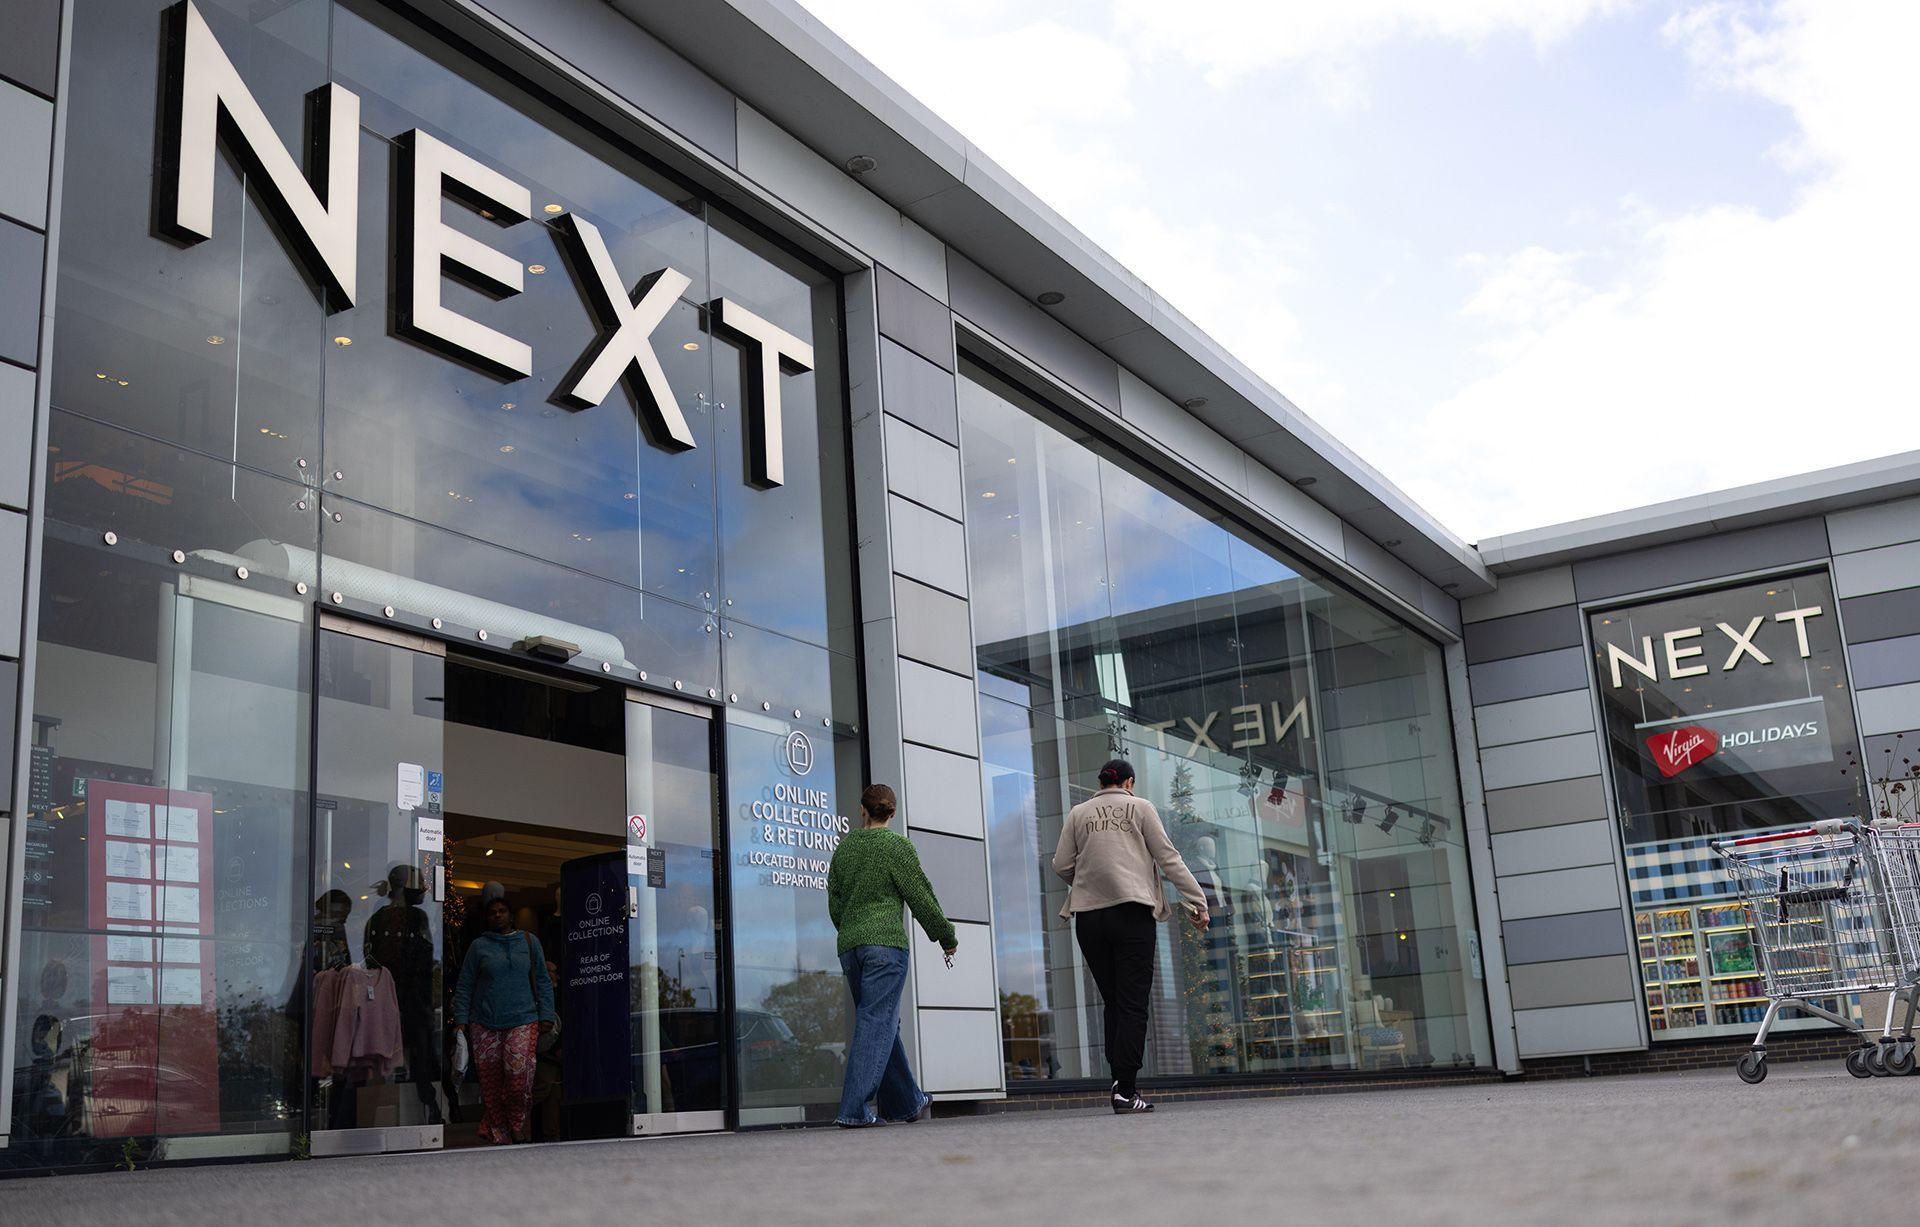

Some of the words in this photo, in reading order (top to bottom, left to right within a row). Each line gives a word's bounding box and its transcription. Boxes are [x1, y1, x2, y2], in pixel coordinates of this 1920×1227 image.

[156, 0, 813, 488] NEXT
[1607, 606, 1823, 688] NEXT
[1663, 731, 1704, 766] Virgin
[1721, 721, 1818, 749] HOLIDAYS
[774, 783, 829, 809] ONLINE
[751, 800, 850, 834] COLLECTIONS
[1086, 819, 1133, 834] nurse.
[763, 824, 774, 843] &
[777, 826, 841, 852] RETURNS
[749, 850, 796, 870] LOCATED
[797, 856, 807, 871] IN
[772, 871, 829, 890] DEPARTMEN
[578, 916, 610, 929] ONLINE
[568, 925, 624, 941] COLLECTIONS
[580, 955, 599, 965] REAR
[600, 953, 610, 962] OF
[580, 963, 611, 975] WOMENS
[569, 976, 598, 987] GROUND
[599, 972, 624, 983] FLOOR
